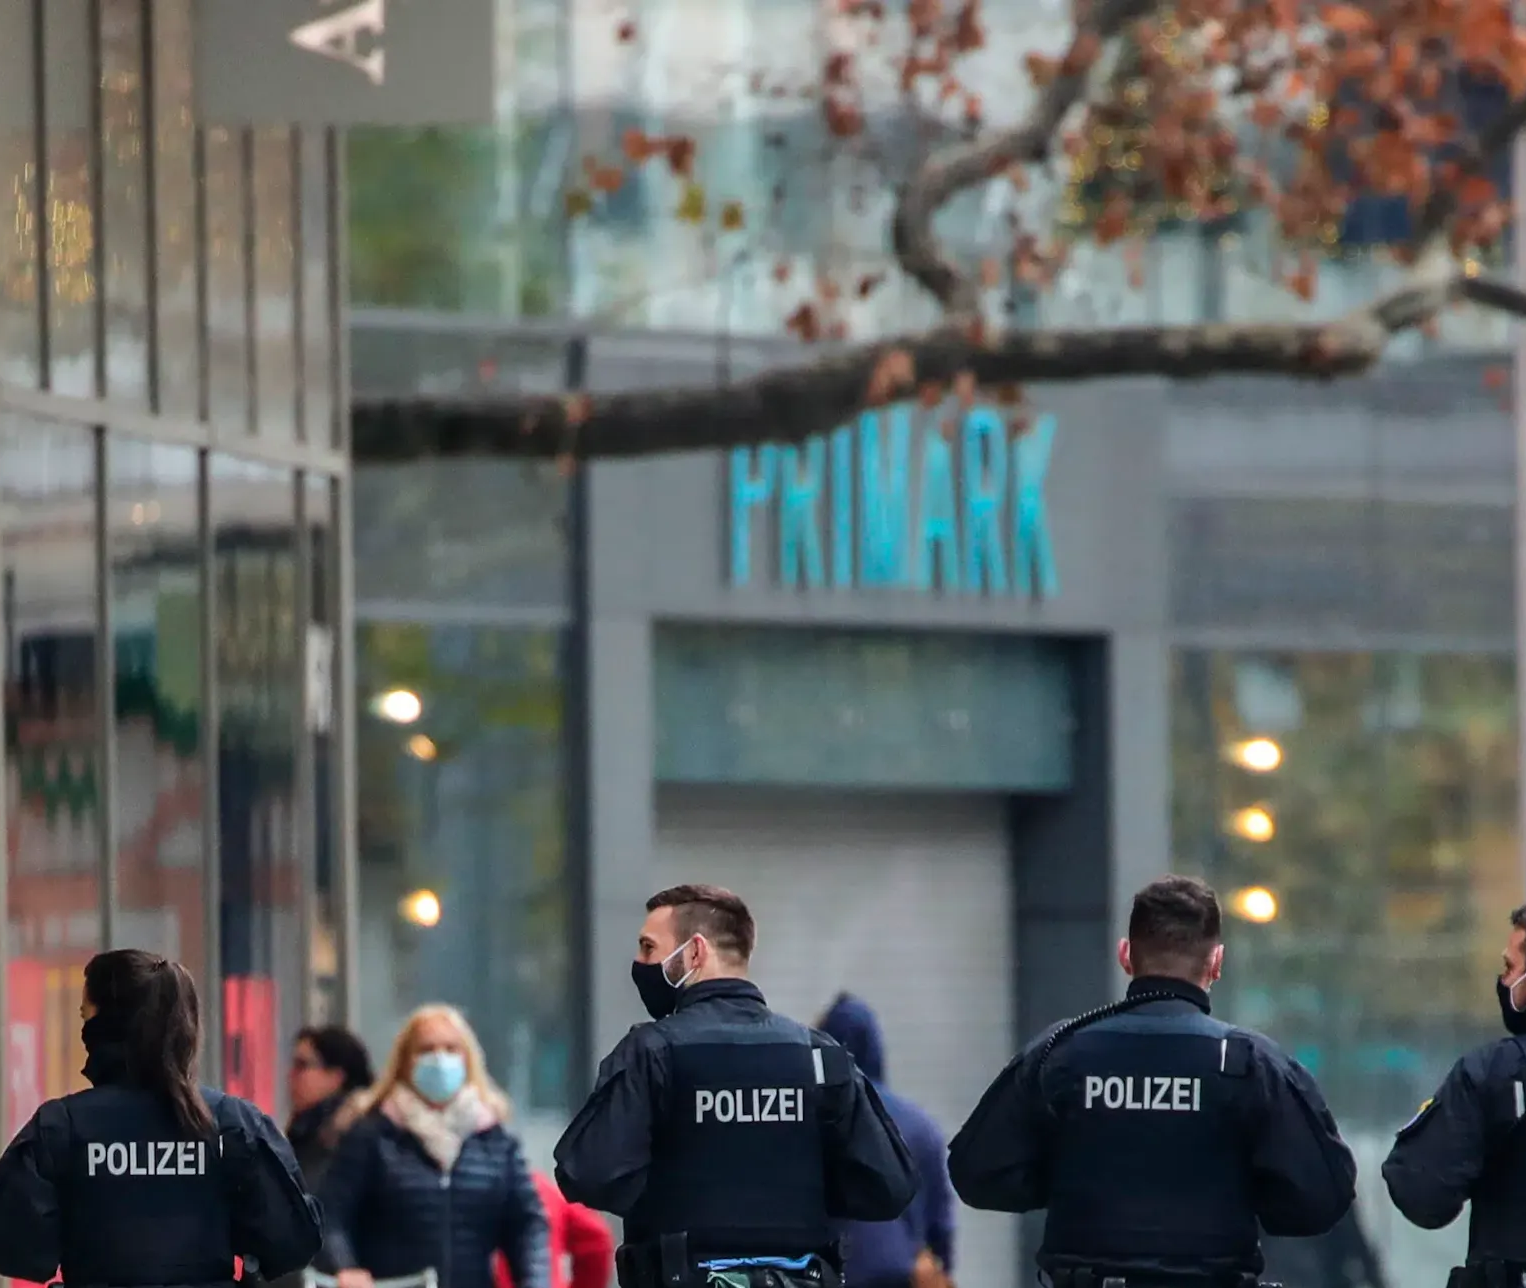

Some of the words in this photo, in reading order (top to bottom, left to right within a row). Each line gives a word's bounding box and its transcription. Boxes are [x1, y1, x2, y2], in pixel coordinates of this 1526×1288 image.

[288, 0, 385, 86] A
[695, 1088, 804, 1123] POLIZEI
[1085, 1076, 1201, 1111] POLIZEI
[87, 1141, 206, 1176] POLIZEI
